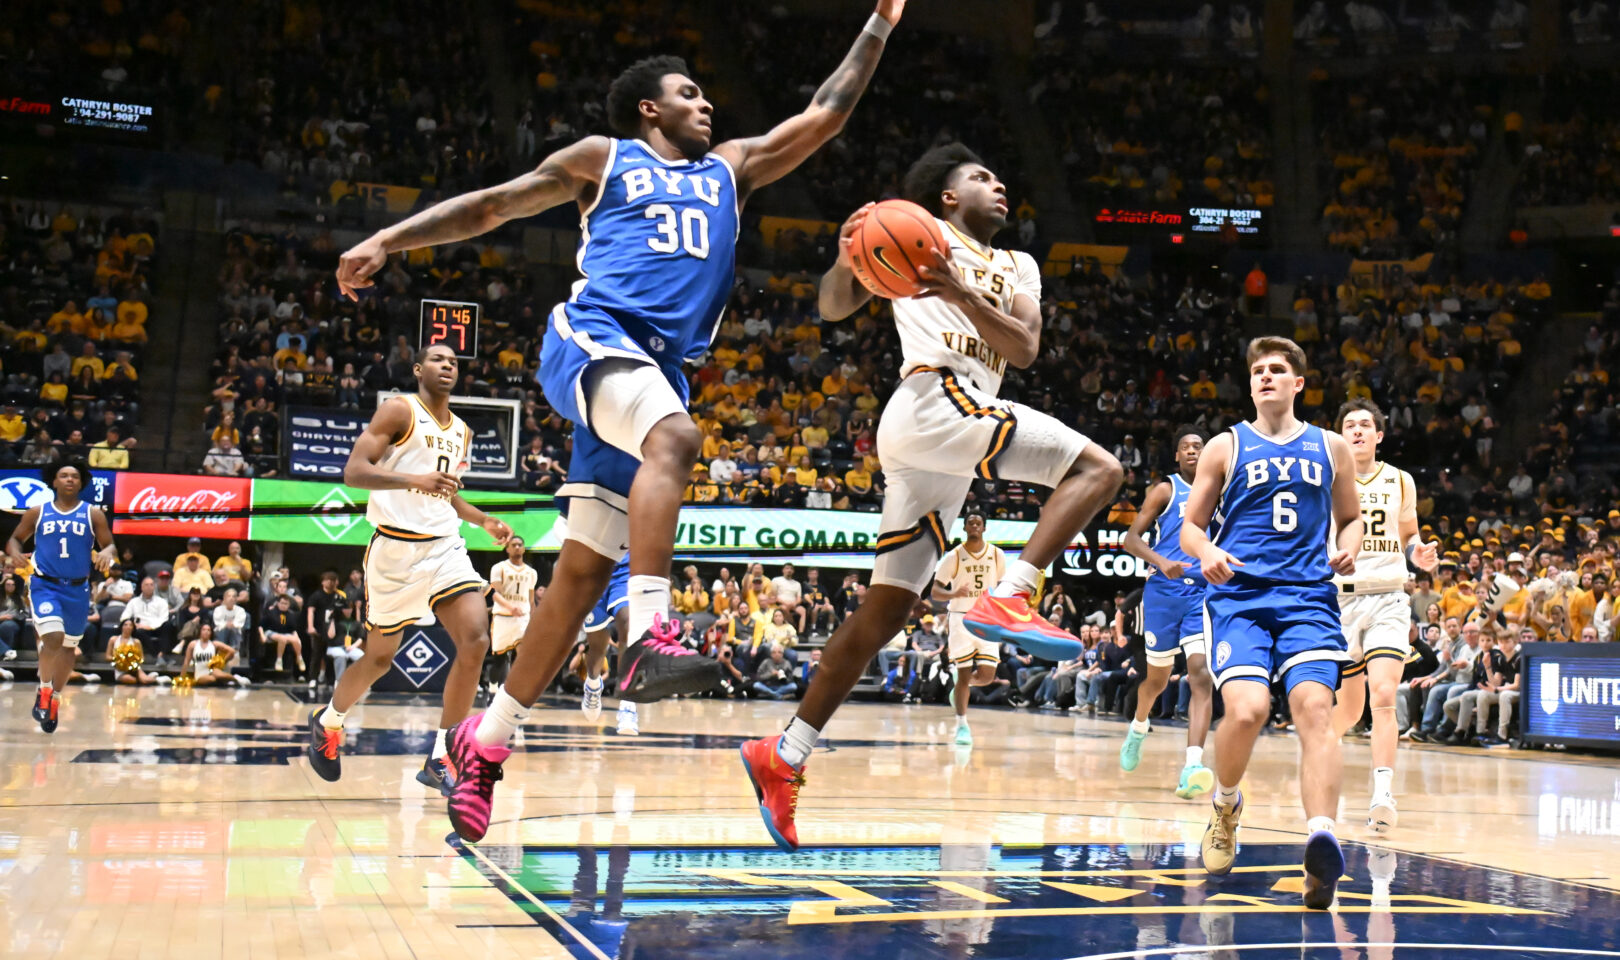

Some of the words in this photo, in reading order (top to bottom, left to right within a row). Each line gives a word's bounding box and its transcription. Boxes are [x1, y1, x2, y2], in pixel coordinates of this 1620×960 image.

[61, 97, 110, 110] CATHRYN
[112, 103, 152, 115] BOSTER
[622, 167, 721, 207] BYU
[1150, 211, 1182, 225] Farm
[1189, 208, 1228, 217] CATHRYN
[1229, 209, 1261, 219] BOSTER
[645, 203, 710, 260] 30
[957, 265, 1015, 302] EST
[432, 307, 447, 322] 17
[452, 309, 471, 325] 46
[431, 322, 466, 351] 27
[292, 442, 351, 456] FOR
[424, 435, 461, 458] WEST
[1244, 457, 1323, 488] BYU
[94, 485, 104, 502] 3
[1360, 493, 1391, 505] EST
[128, 486, 237, 524] Coca-Cola
[1272, 491, 1298, 533] 6
[42, 520, 86, 536] BYU
[59, 537, 70, 558] 1
[755, 527, 878, 550] GOMAR
[965, 564, 991, 573] WEST
[974, 574, 984, 589] 5
